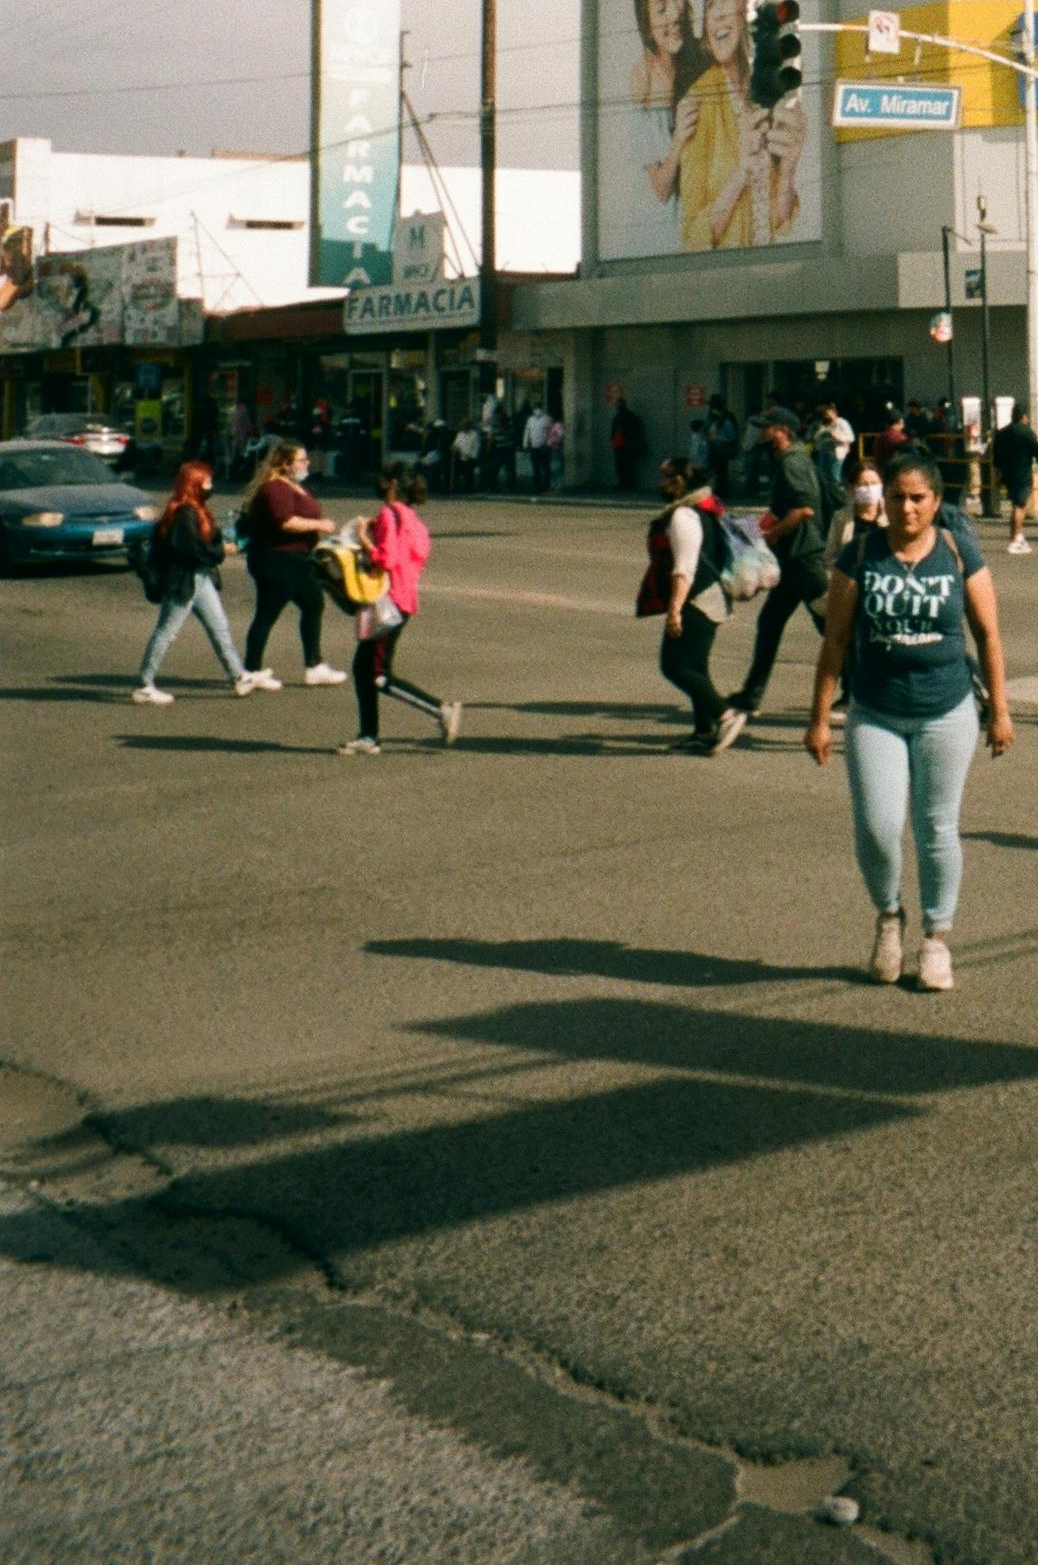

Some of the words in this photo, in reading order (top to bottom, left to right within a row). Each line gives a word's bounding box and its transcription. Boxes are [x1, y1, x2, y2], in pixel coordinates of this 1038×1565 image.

[845, 93, 871, 113] Av.
[880, 94, 949, 115] Miramar
[342, 89, 373, 285] FARMACIA
[347, 285, 475, 320] FARMACIA
[865, 592, 946, 618] QUIT
